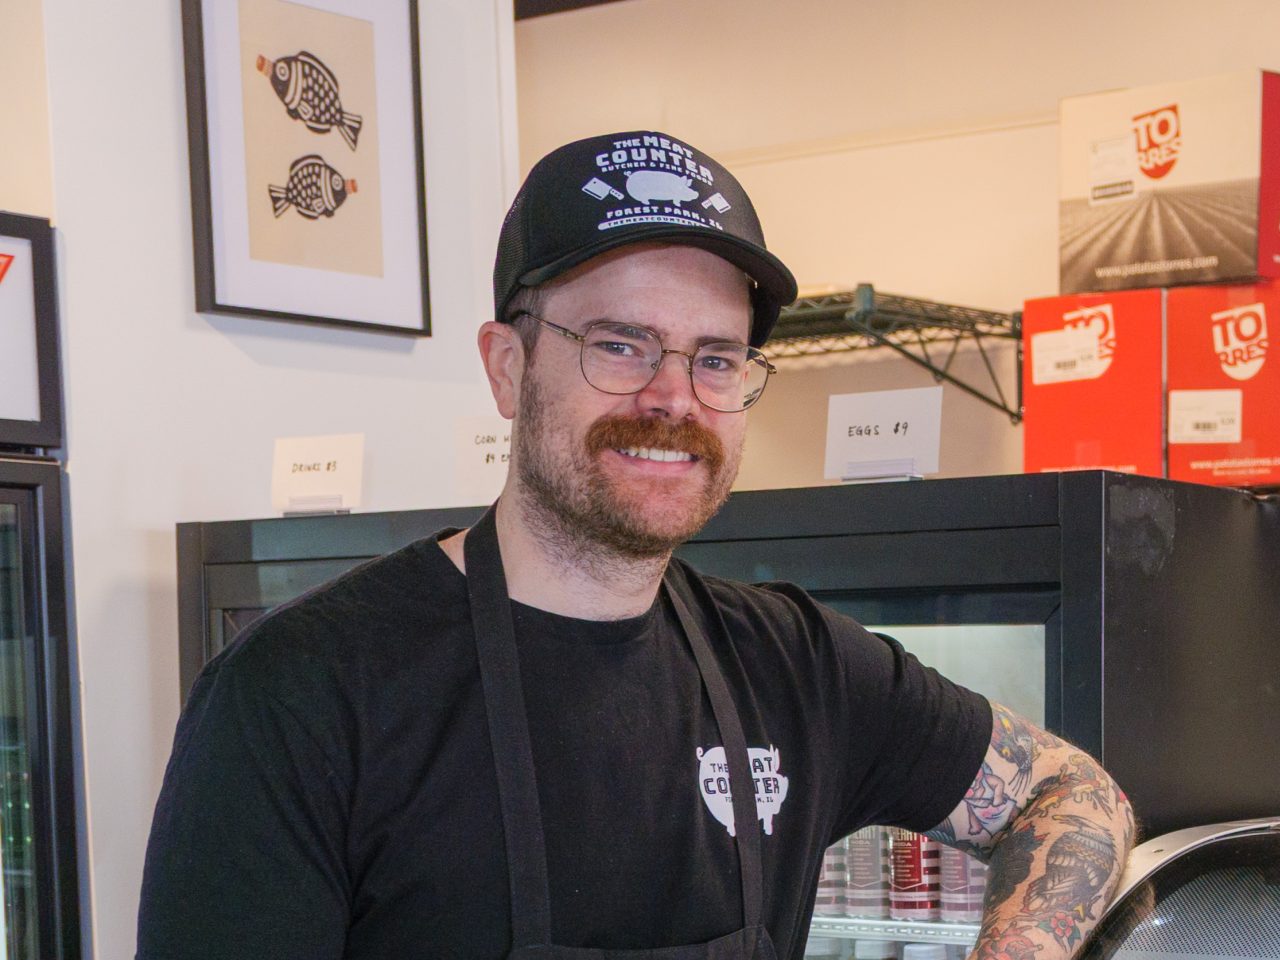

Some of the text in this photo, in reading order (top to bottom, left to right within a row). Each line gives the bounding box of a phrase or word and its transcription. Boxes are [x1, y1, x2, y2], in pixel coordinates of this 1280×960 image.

[1133, 109, 1178, 151] TO
[613, 135, 694, 159] THE MEAT
[595, 147, 714, 183] COUNTER
[601, 161, 647, 173] BUTCHER
[659, 162, 683, 173] FINE
[685, 169, 713, 187] FOODS
[606, 205, 659, 219] FOREST
[664, 206, 706, 223] PARK,
[1212, 310, 1263, 348] TO
[1218, 339, 1270, 367] RRES
[848, 421, 909, 437] EGGS $9
[474, 434, 497, 446] CORN
[291, 460, 338, 474] DRINKS $3
[709, 757, 773, 774] THE AT
[703, 776, 780, 795] COTER
